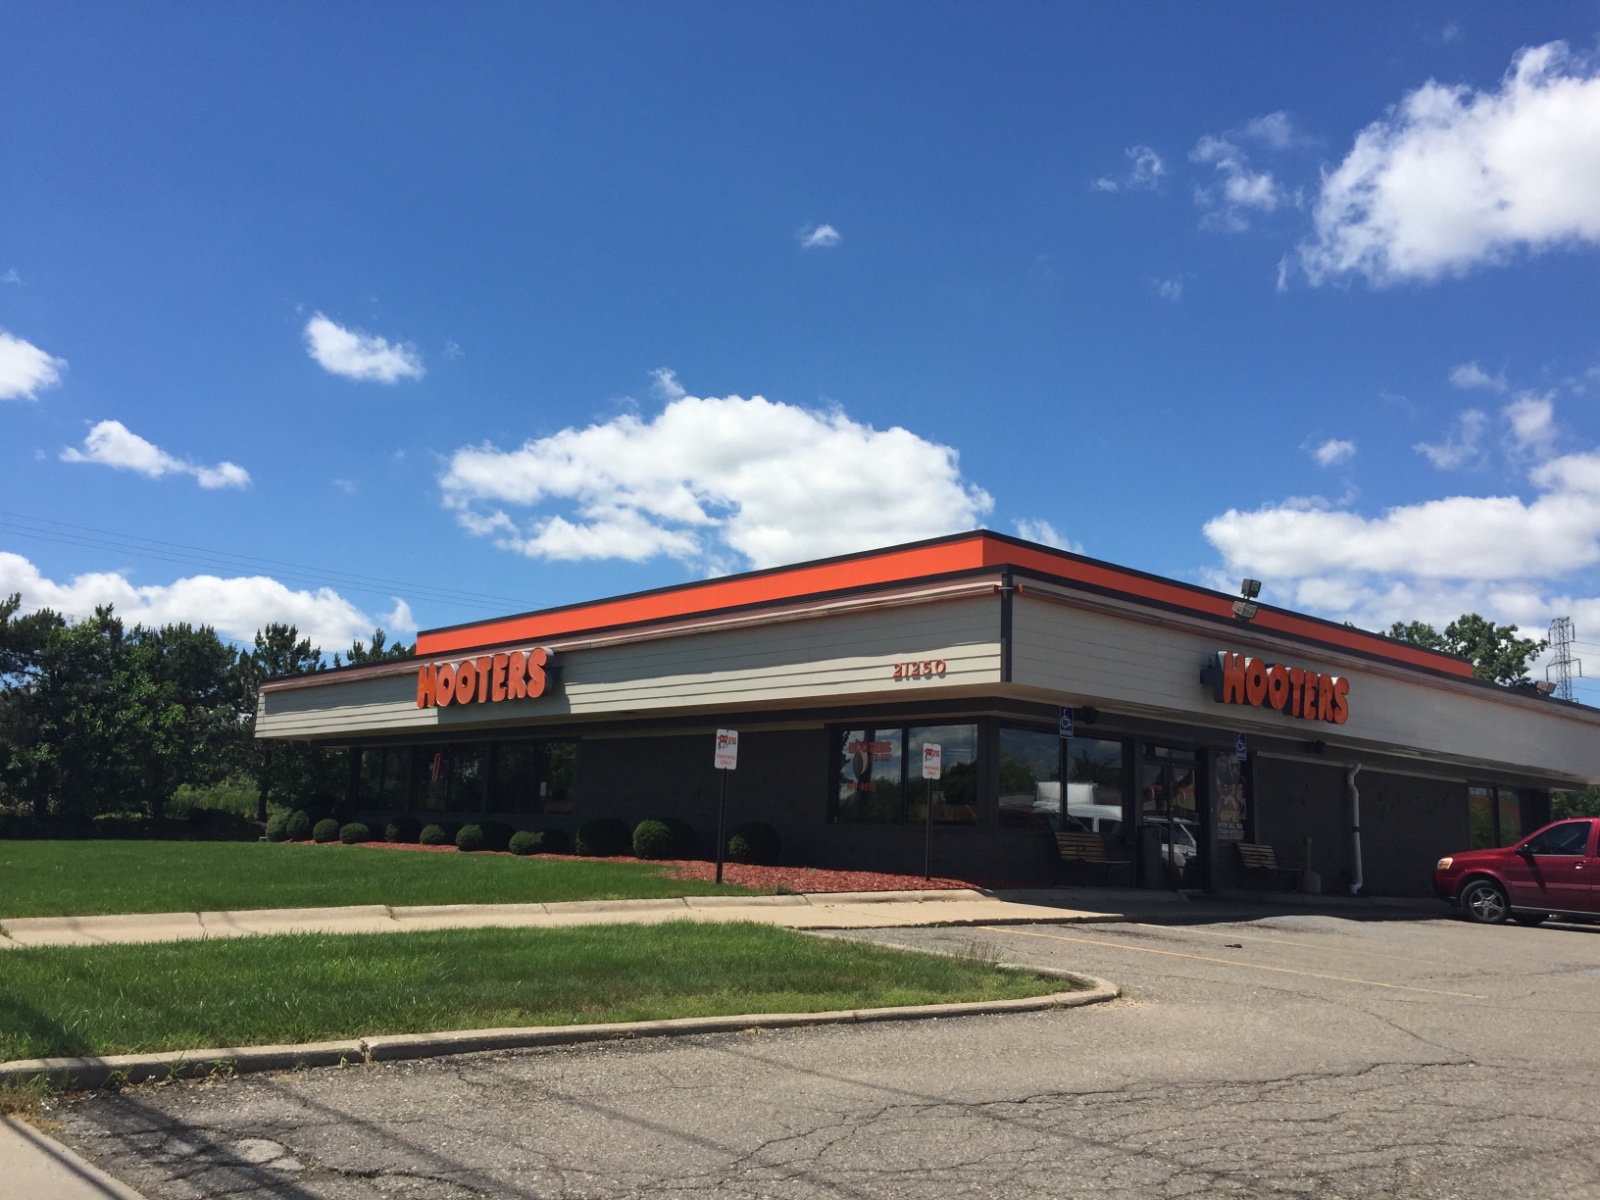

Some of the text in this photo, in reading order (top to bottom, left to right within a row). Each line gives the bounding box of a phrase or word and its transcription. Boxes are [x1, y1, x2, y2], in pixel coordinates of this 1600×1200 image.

[416, 647, 550, 709] HOOTERS
[892, 659, 947, 678] 21250
[1221, 650, 1350, 725] HOOTERS
